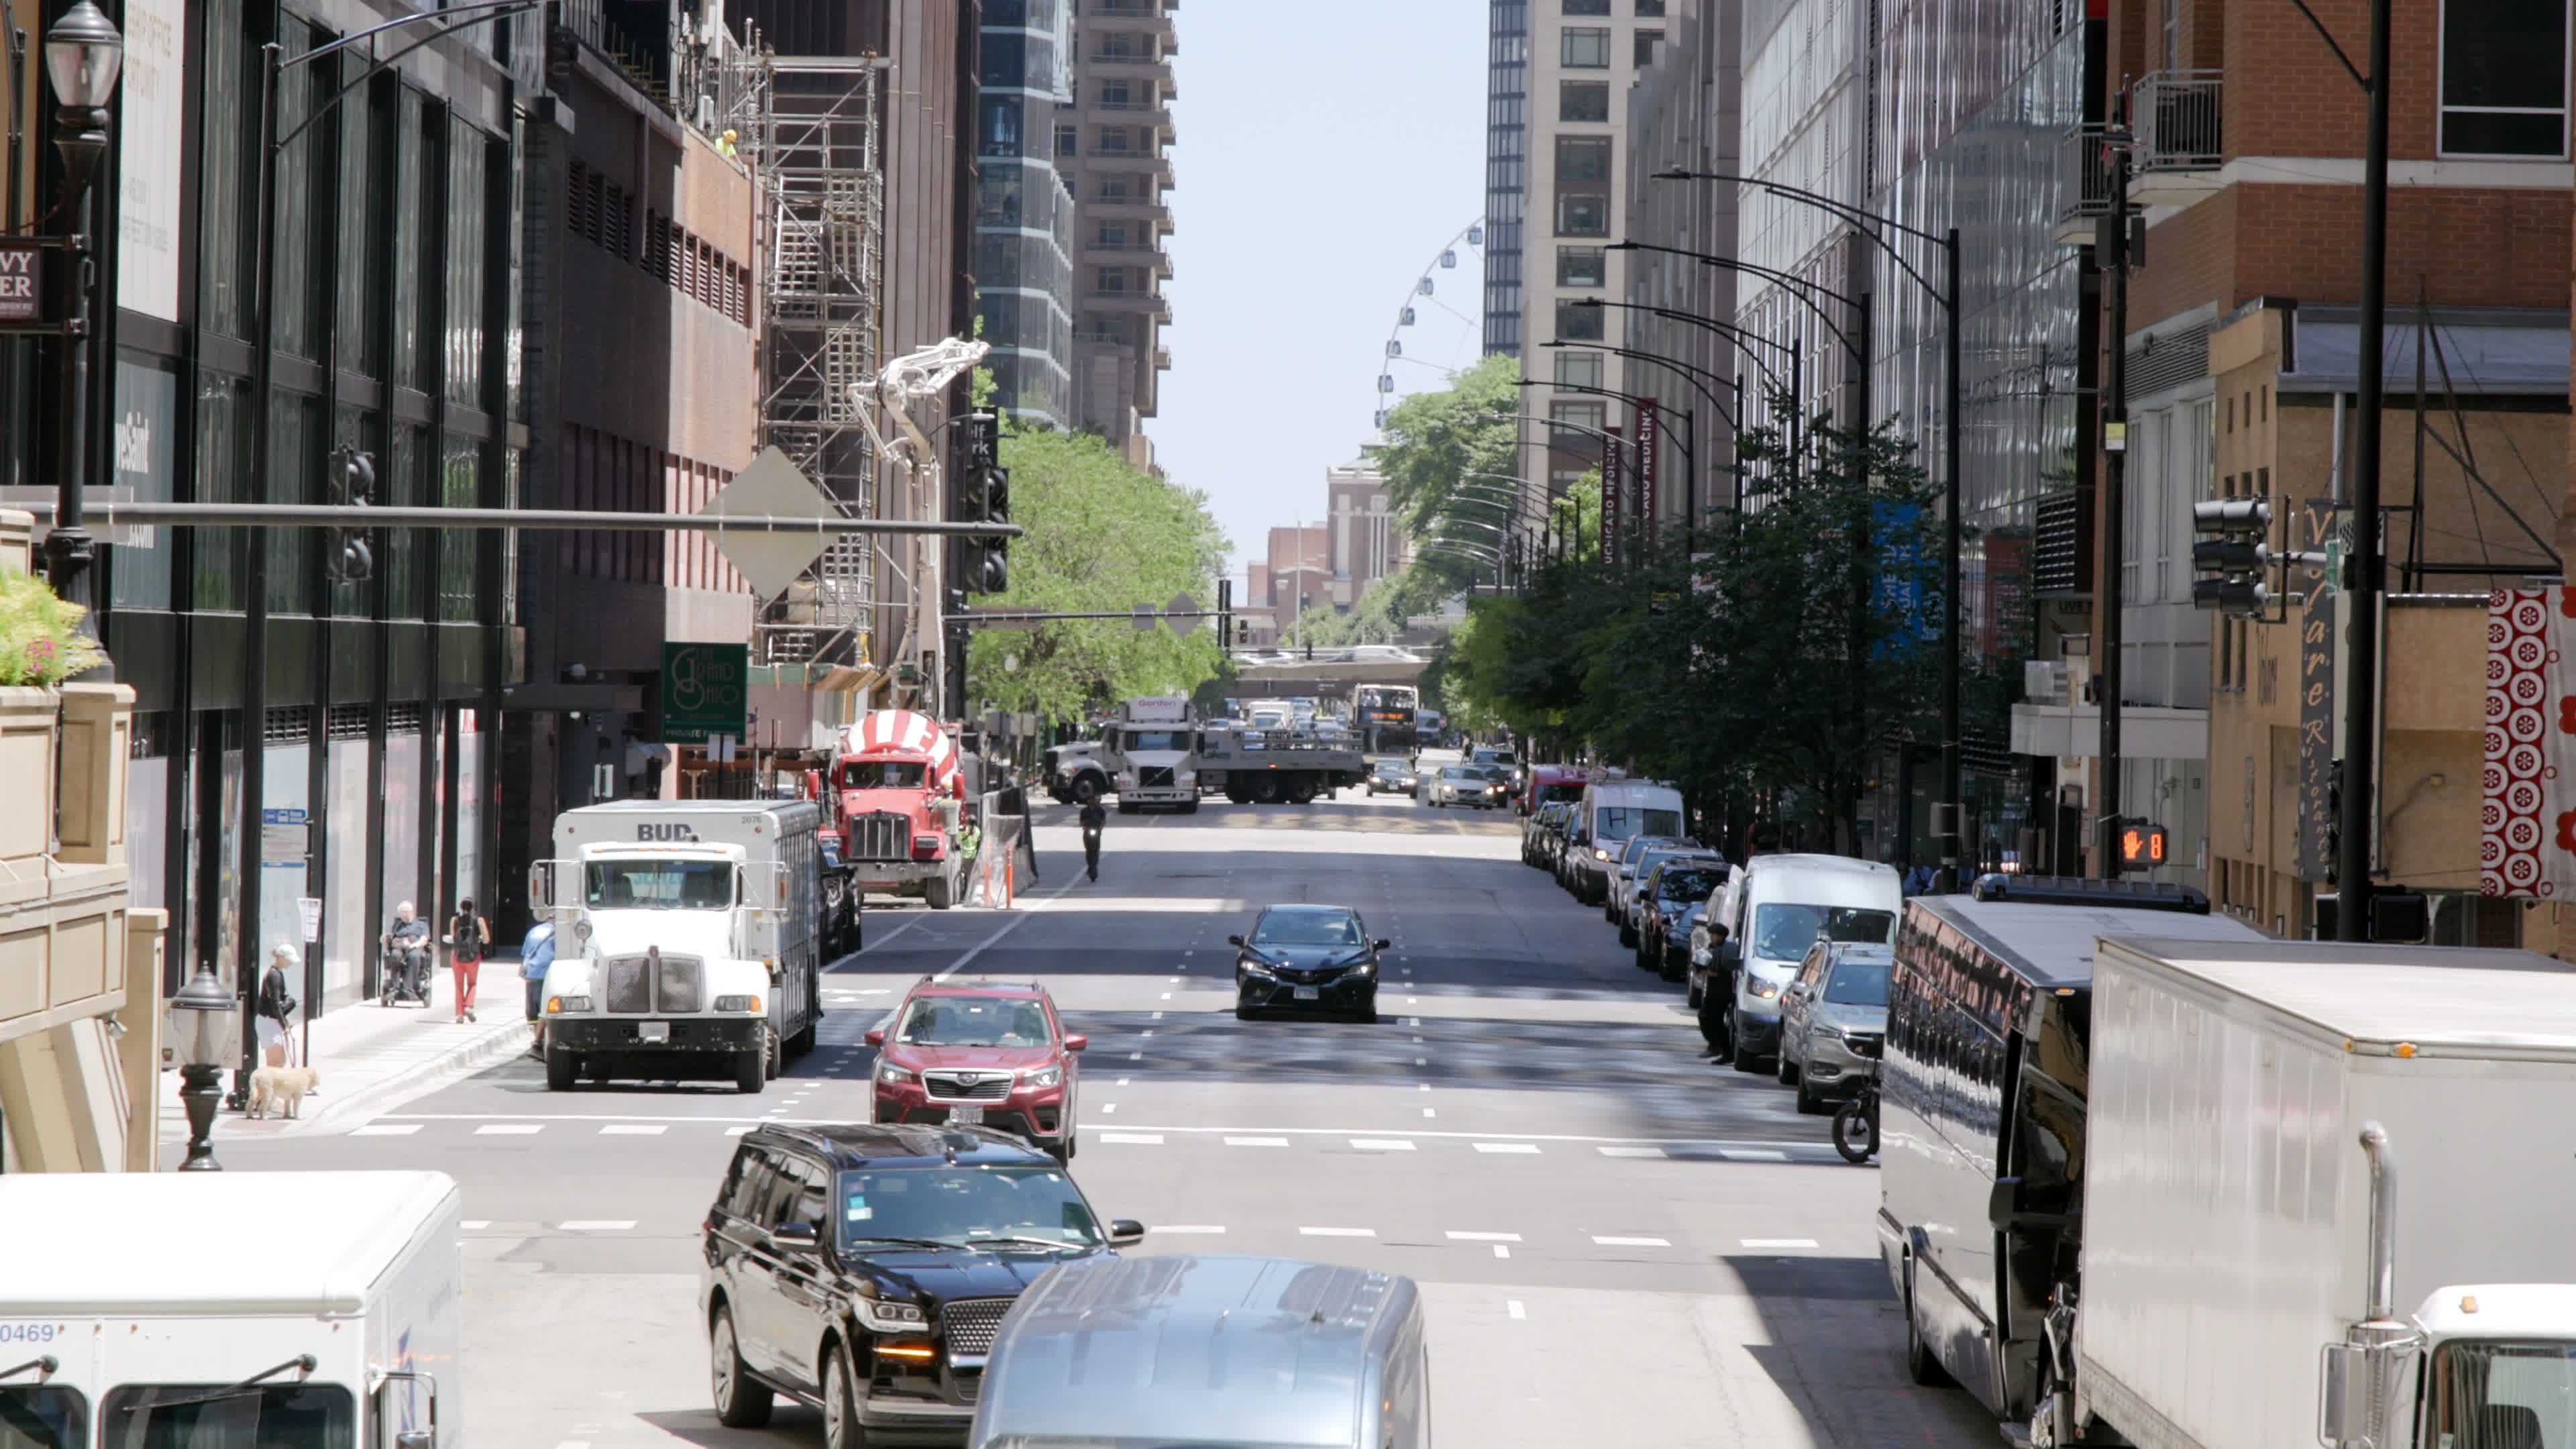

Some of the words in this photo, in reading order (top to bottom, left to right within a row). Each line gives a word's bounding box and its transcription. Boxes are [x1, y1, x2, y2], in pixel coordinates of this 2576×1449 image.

[665, 729, 702, 738] PRIVATE
[638, 824, 692, 842] BUD
[2150, 834, 2162, 859] 8
